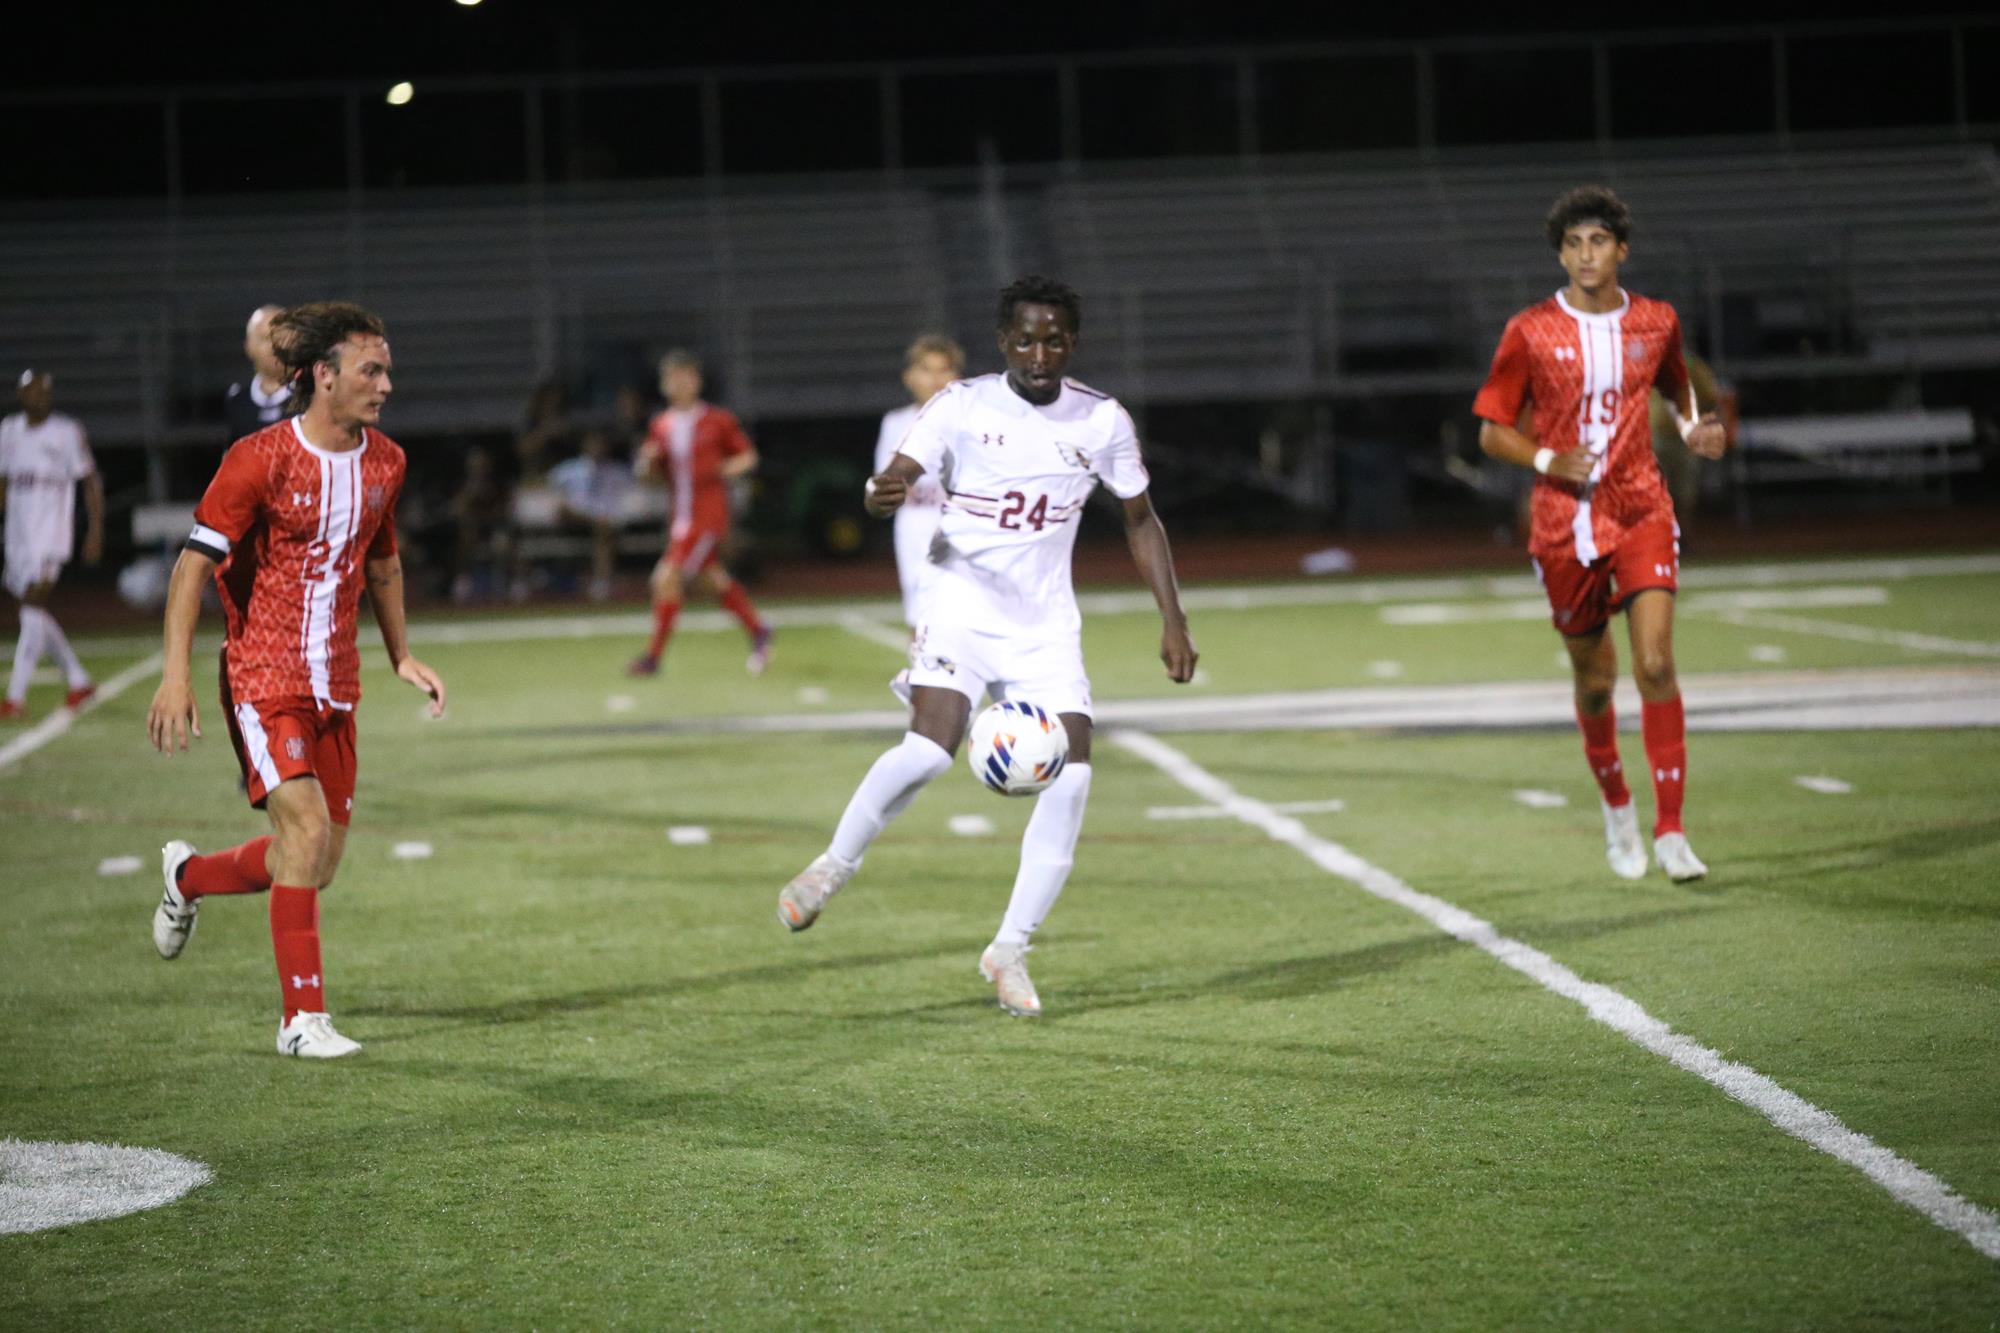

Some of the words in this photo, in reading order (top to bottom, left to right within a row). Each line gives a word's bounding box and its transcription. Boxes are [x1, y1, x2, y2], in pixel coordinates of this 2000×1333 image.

[1582, 389, 1618, 425] 19
[999, 490, 1047, 532] 24
[303, 540, 353, 582] 24
